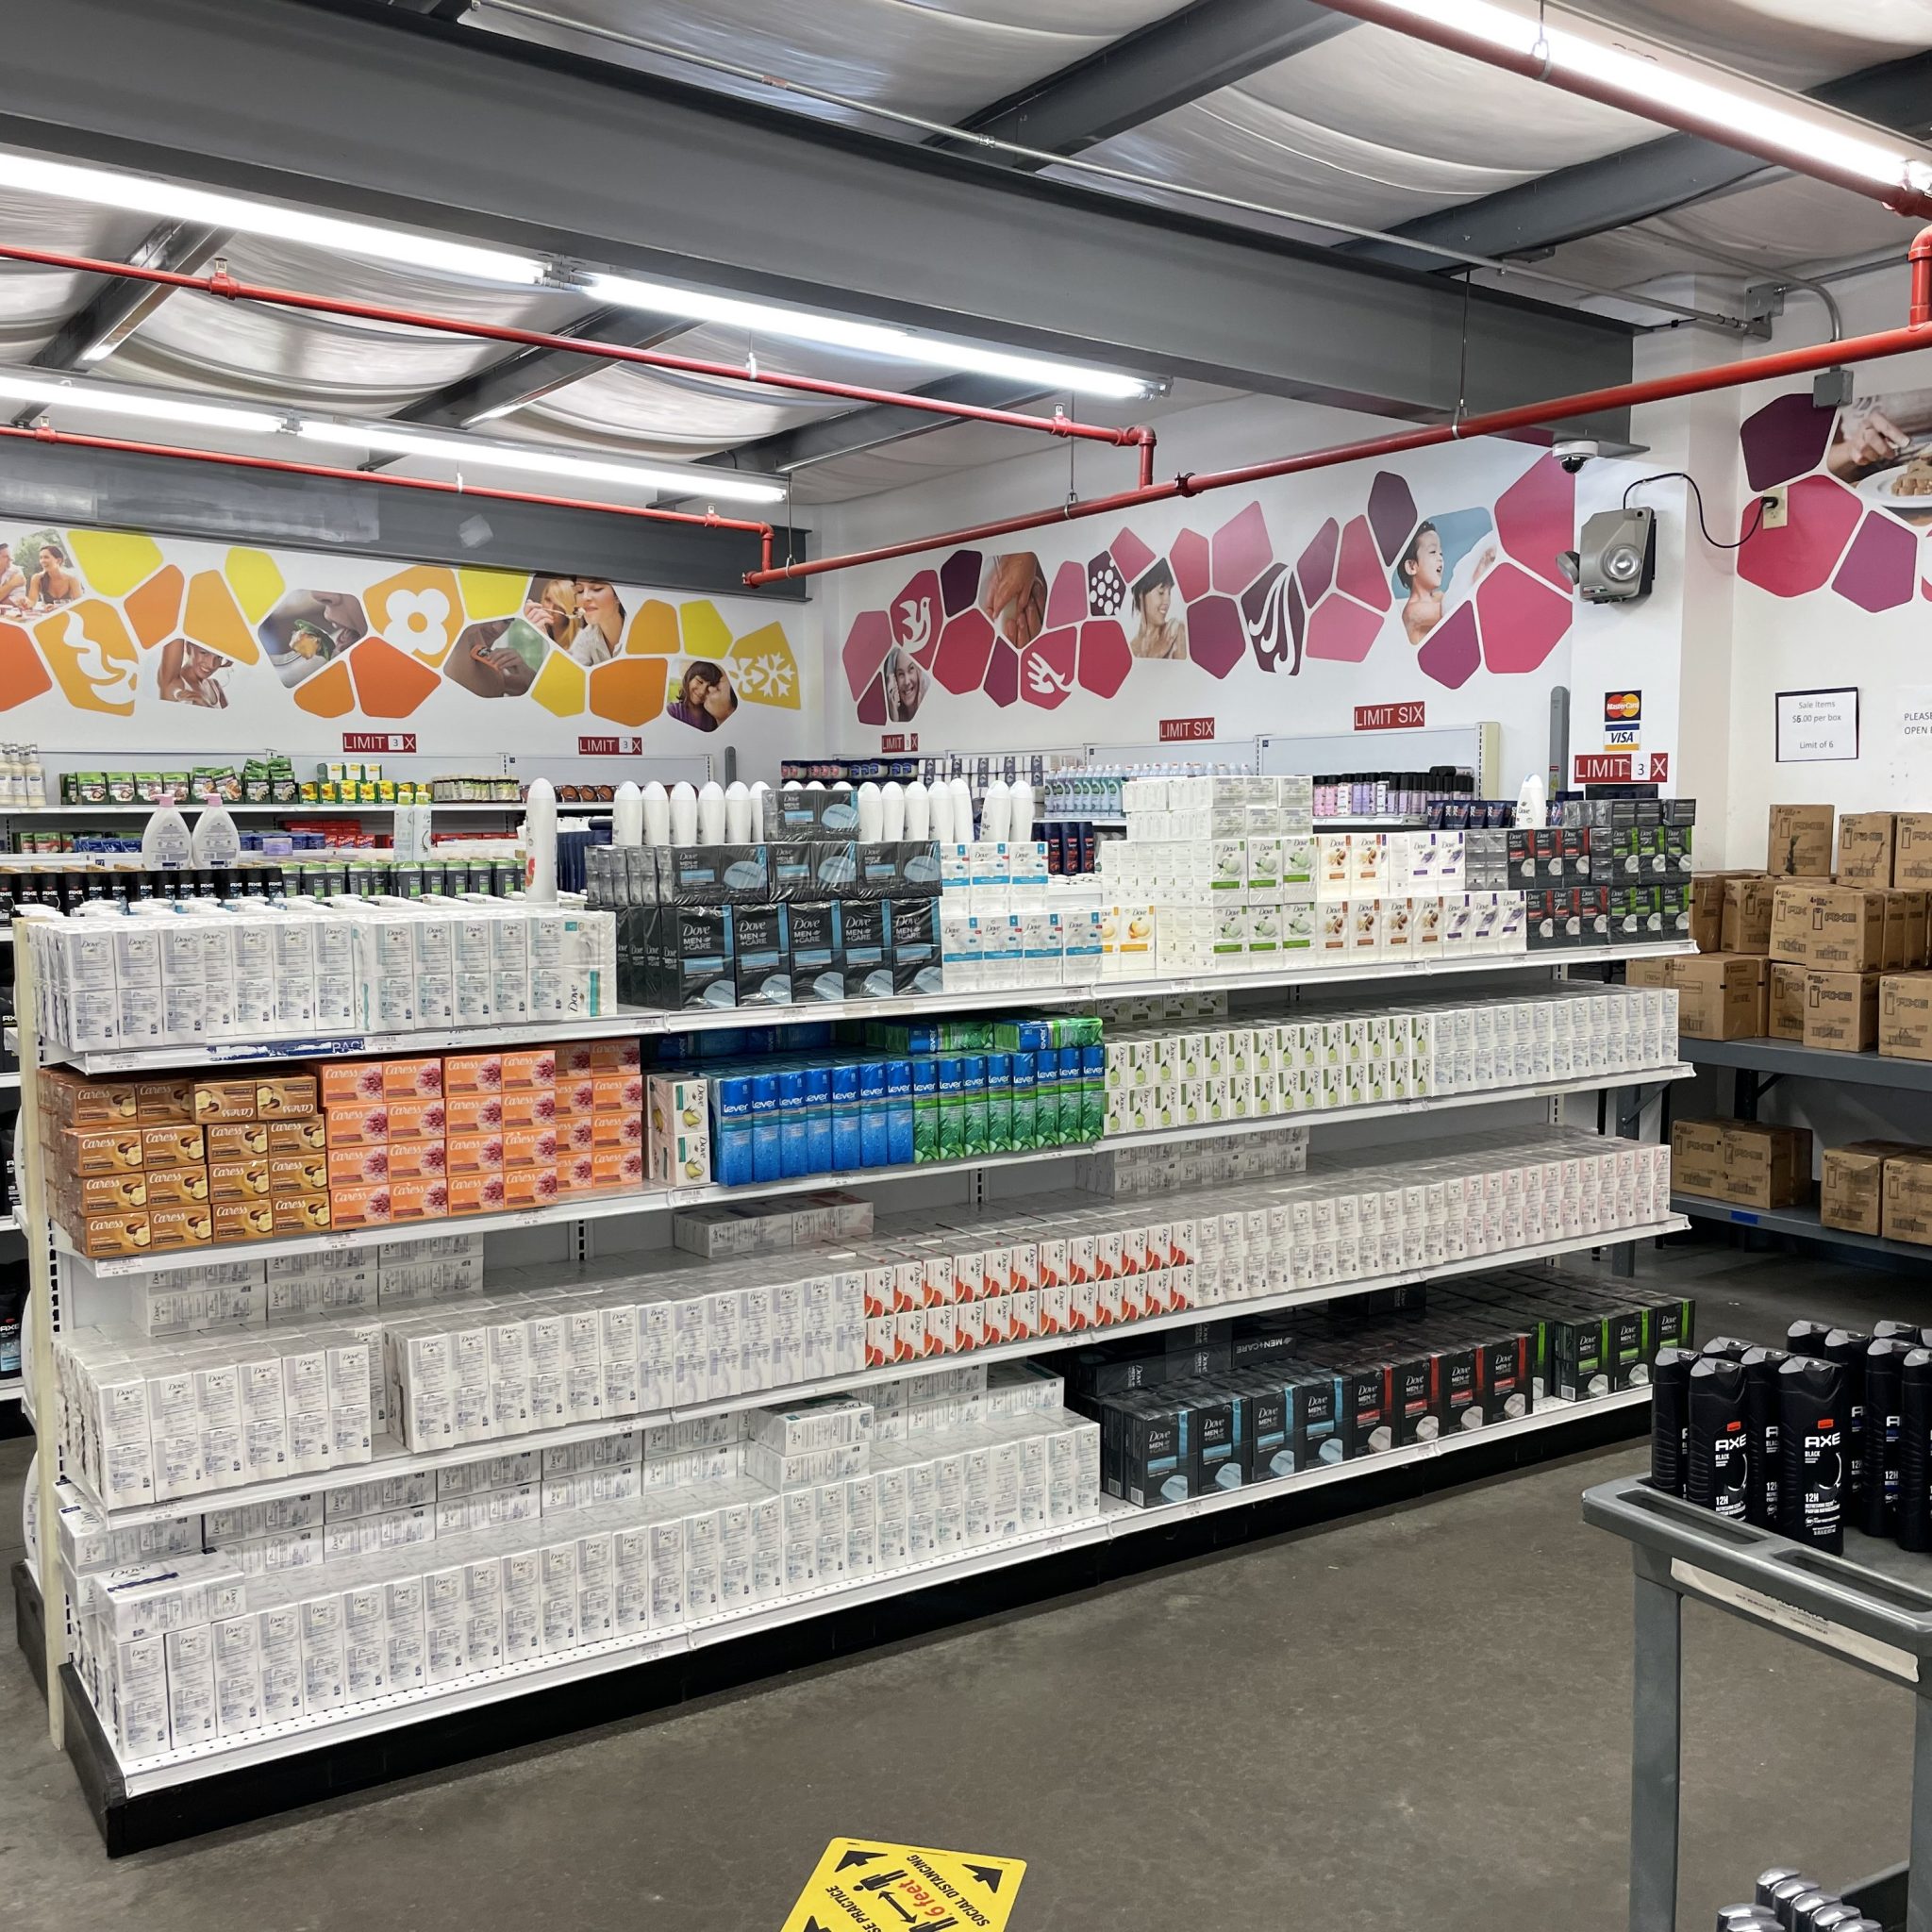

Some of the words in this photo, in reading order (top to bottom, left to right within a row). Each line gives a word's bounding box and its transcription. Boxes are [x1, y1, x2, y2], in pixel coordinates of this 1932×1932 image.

[1355, 708, 1394, 726] LIMIT
[1398, 706, 1424, 724] SIX
[1813, 715, 1825, 725] per
[1160, 723, 1191, 738] LIMIT
[1193, 721, 1213, 736] SIX
[344, 737, 385, 749] LIMIT
[405, 737, 415, 749] X
[883, 737, 902, 749] LIMIT
[912, 736, 917, 747] X
[1610, 732, 1633, 742] VISA
[579, 740, 615, 752] LIMIT
[632, 741, 641, 752] X
[1575, 758, 1628, 777] LIMIT
[1638, 763, 1644, 775] 3
[1652, 758, 1666, 776] X
[740, 920, 766, 932] Dove
[793, 917, 821, 930] Dove
[845, 916, 872, 928] Dove
[896, 915, 920, 926] Dove
[683, 924, 710, 936] Dove
[568, 985, 577, 1011] Dove
[504, 1055, 534, 1069] Caress
[325, 1065, 358, 1080] Caress
[386, 1063, 417, 1077] Caress
[77, 1089, 110, 1101] Caress
[505, 1093, 534, 1108] Caress
[283, 1103, 314, 1114] Caress
[448, 1097, 479, 1112] Caress
[222, 1107, 254, 1118] Caress
[332, 1108, 364, 1123] Caress
[210, 1126, 242, 1138] Caress
[271, 1121, 302, 1133] Caress
[82, 1138, 116, 1150] Caress
[145, 1132, 178, 1144] Caress
[450, 1139, 481, 1152] Caress
[594, 1152, 622, 1165] Caress
[213, 1166, 244, 1178] Caress
[272, 1160, 303, 1173] Caress
[86, 1178, 120, 1191] Caress
[149, 1172, 182, 1185] Caress
[335, 1191, 367, 1205] Caress
[216, 1205, 248, 1217] Caress
[275, 1199, 307, 1211] Caress
[154, 1212, 186, 1224] Caress
[91, 1219, 124, 1232] Caress
[1661, 1316, 1676, 1324] Dove
[1621, 1325, 1637, 1336] Dove
[1579, 1335, 1596, 1345] Dove
[1495, 1355, 1512, 1364] Dove
[1452, 1366, 1471, 1376] Dove
[1406, 1374, 1424, 1386] Dove
[1358, 1384, 1378, 1395] Dove
[1307, 1395, 1328, 1407] Dove
[1258, 1407, 1278, 1419] Dove
[1204, 1418, 1224, 1430] Dove
[1149, 1430, 1171, 1442] Dove
[1715, 1433, 1746, 1451] AXE
[1805, 1432, 1840, 1448] AXE
[1148, 1441, 1163, 1450] MEN
[1885, 1471, 1898, 1479] 12H
[1716, 1496, 1728, 1506] 12H
[1805, 1493, 1819, 1503] 12H
[907, 1855, 959, 1902] DISTANCING
[898, 1879, 936, 1907] feet
[825, 1886, 866, 1924] PRACTICE
[955, 1896, 991, 1926] SOCIAL
[924, 1906, 945, 1917] 6
